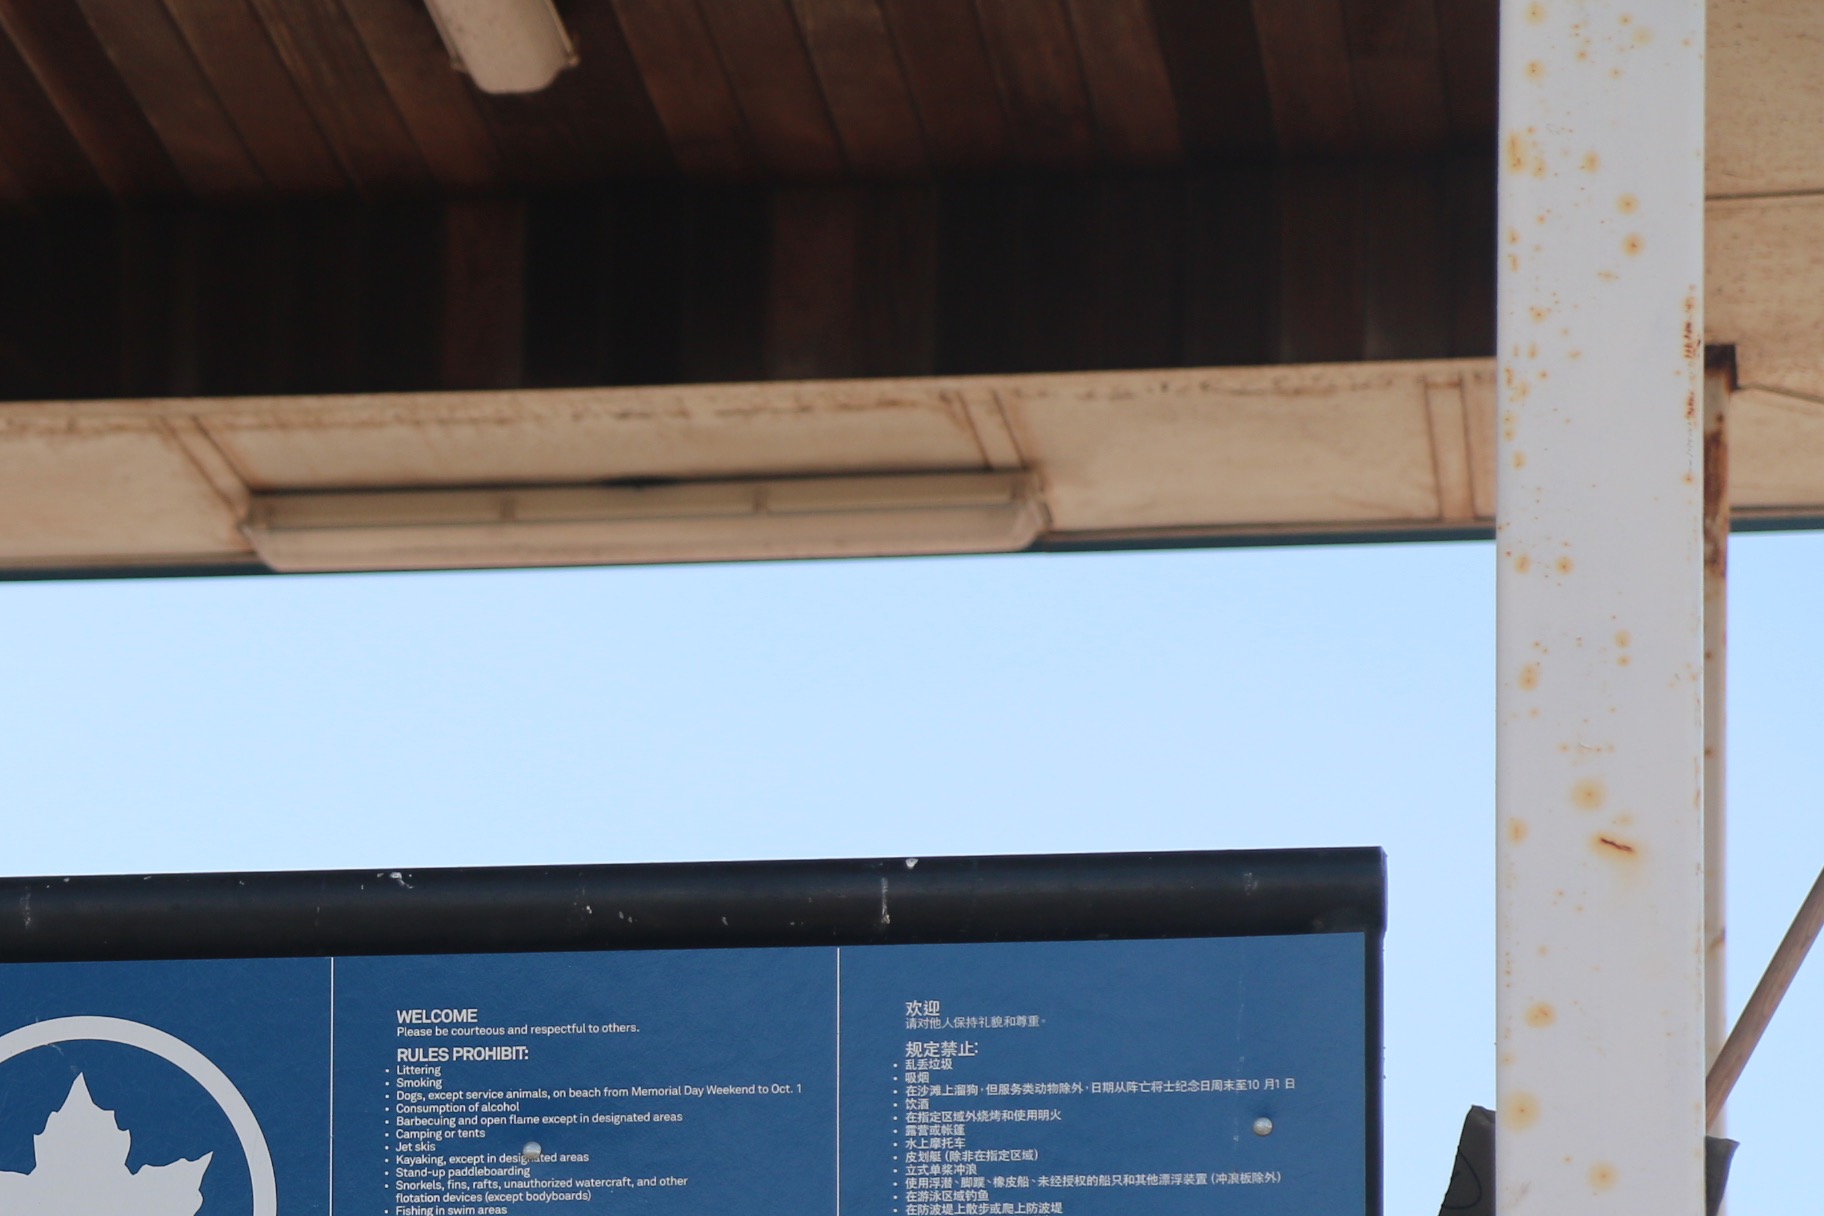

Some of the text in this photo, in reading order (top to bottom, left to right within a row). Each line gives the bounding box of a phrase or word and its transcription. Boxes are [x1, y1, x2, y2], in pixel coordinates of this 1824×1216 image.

[396, 1008, 478, 1023] WELCOME
[905, 1000, 940, 1017] 欢迎
[396, 1021, 639, 1037] Please be courteous and respectful to others.
[396, 1046, 528, 1061] RULES PROHIBIT:
[396, 1063, 441, 1077] Littering
[905, 1071, 930, 1084] 吸烟
[395, 1076, 442, 1090] Smoking
[396, 1082, 801, 1102] Dogs, except service animals, on beach from Memorial Day Weekend to Oct. 1
[395, 1100, 519, 1115] Consumption of alcohol
[395, 1127, 485, 1141] Camping or tents
[395, 1140, 436, 1151] Jet skis
[395, 1152, 446, 1167] Kayaking,
[448, 1153, 484, 1166] except
[486, 1152, 496, 1163] in
[559, 1153, 589, 1162] areas
